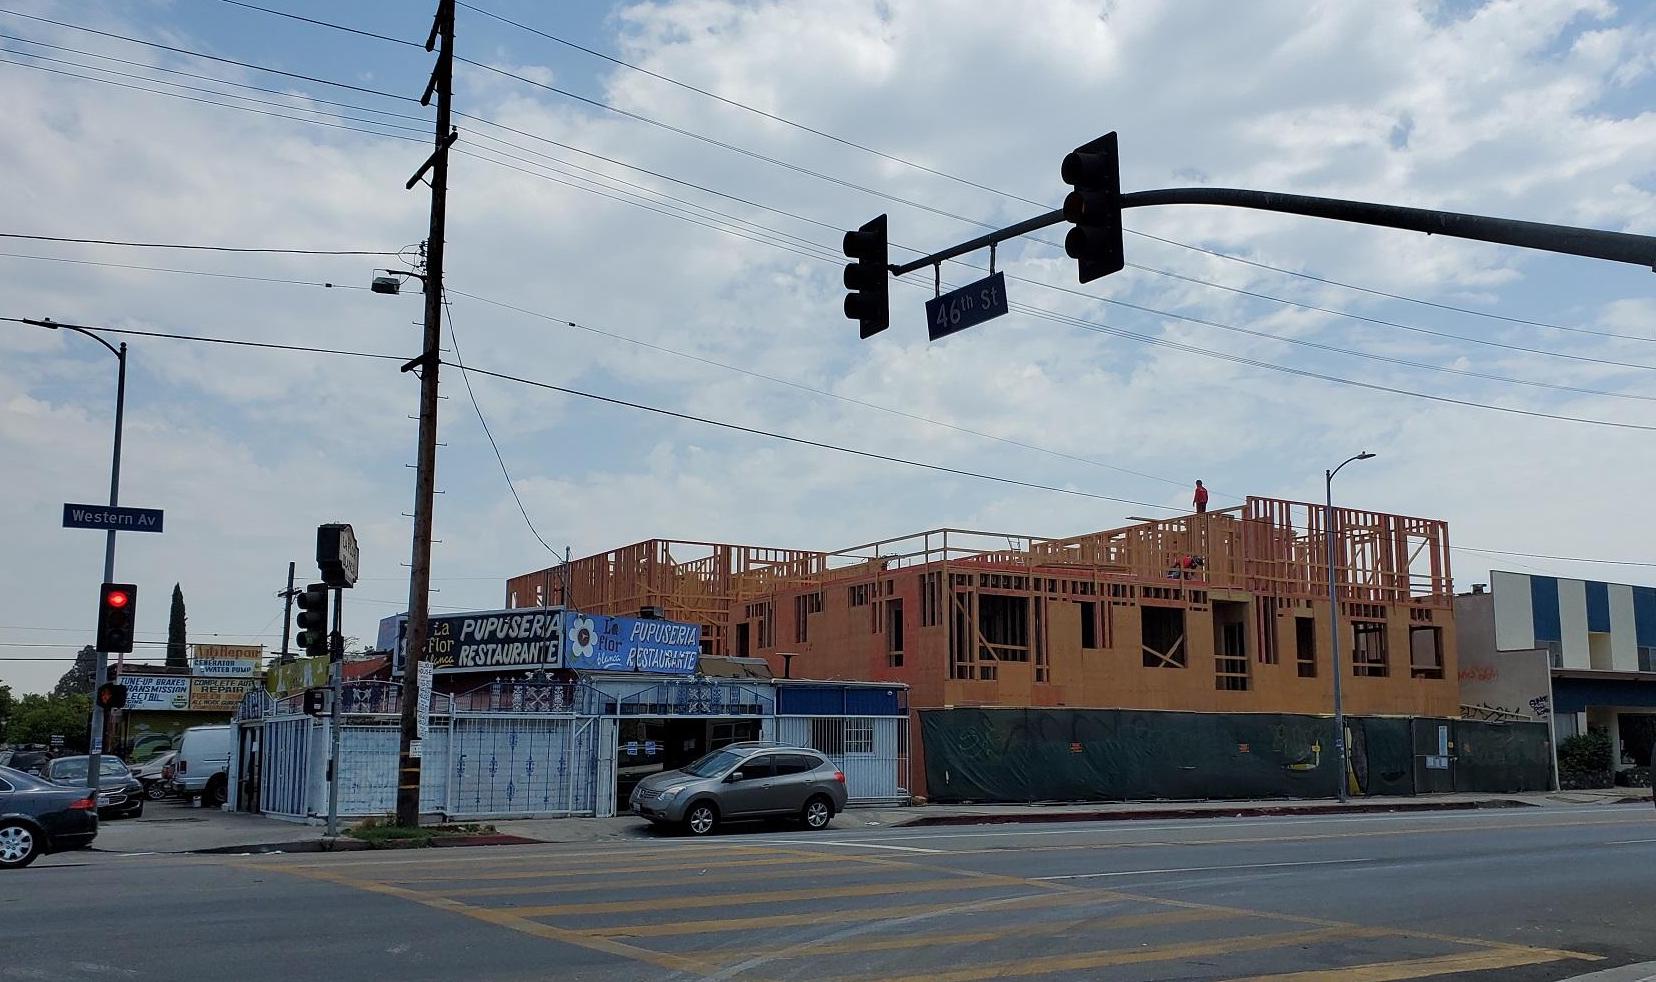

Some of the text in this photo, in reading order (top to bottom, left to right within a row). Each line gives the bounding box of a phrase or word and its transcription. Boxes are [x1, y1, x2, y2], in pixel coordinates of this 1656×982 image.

[936, 286, 999, 328] 46th St
[72, 509, 156, 526] Western Av
[460, 613, 561, 641] PUPUSERIA
[604, 619, 620, 635] La
[630, 621, 697, 646] PUPUSERIA
[428, 636, 455, 654] flor
[599, 635, 622, 652] flor
[220, 646, 261, 660] Repair
[458, 640, 559, 667] RESTAURANTE
[596, 652, 621, 668] blanca
[626, 647, 698, 671] RESTAURANTE
[193, 659, 235, 667] GENERATOR
[120, 677, 186, 686] TUNE-UP BRAKES
[127, 685, 187, 693] RANSMISSION
[193, 679, 236, 687] COMPLETE
